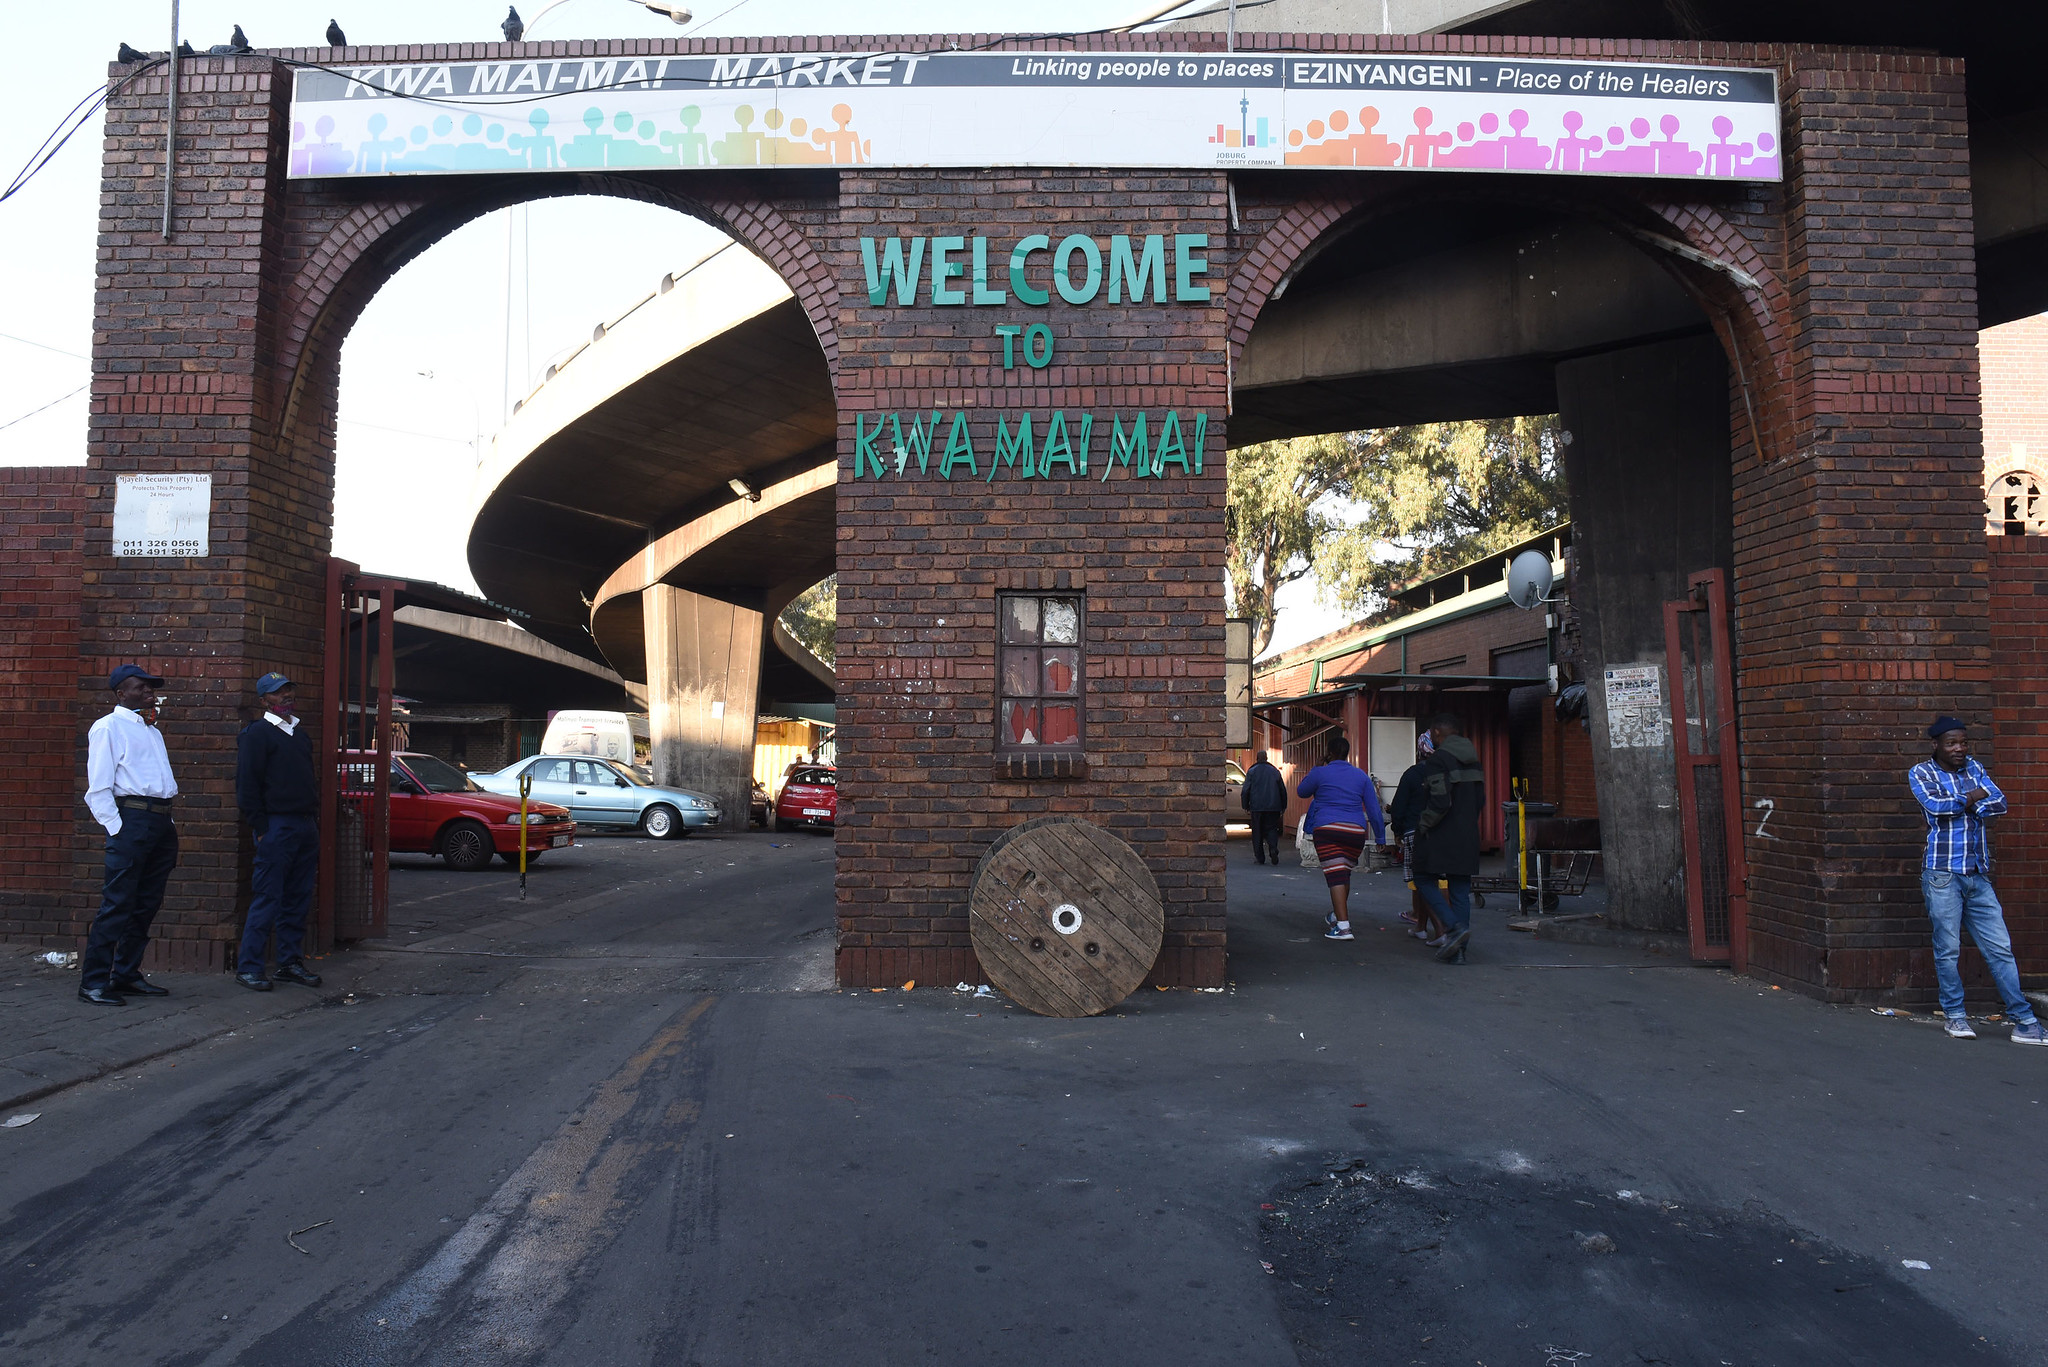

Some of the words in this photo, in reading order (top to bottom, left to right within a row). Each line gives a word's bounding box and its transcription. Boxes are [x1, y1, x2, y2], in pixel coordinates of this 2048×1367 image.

[345, 66, 454, 98] KWA
[468, 59, 669, 94] MAI-MAI
[708, 55, 930, 87] MARKET
[1011, 58, 1092, 80] Linking
[1096, 59, 1170, 80] people
[1177, 60, 1198, 76] to
[1203, 60, 1274, 80] places
[1293, 62, 1472, 87] EZINYANGENI
[1496, 67, 1562, 89] Place
[1569, 70, 1594, 90] of
[1598, 71, 1634, 92] the
[1641, 73, 1730, 96] Healers
[859, 233, 1211, 306] WELCOME
[995, 323, 1054, 370] TO
[854, 409, 978, 480] KWA
[987, 410, 1093, 483] MAI
[1101, 410, 1208, 483] MAI
[145, 475, 173, 484] Security
[176, 475, 193, 484] (Pty)
[195, 475, 208, 483] Ltd
[1754, 798, 1780, 841] 2
